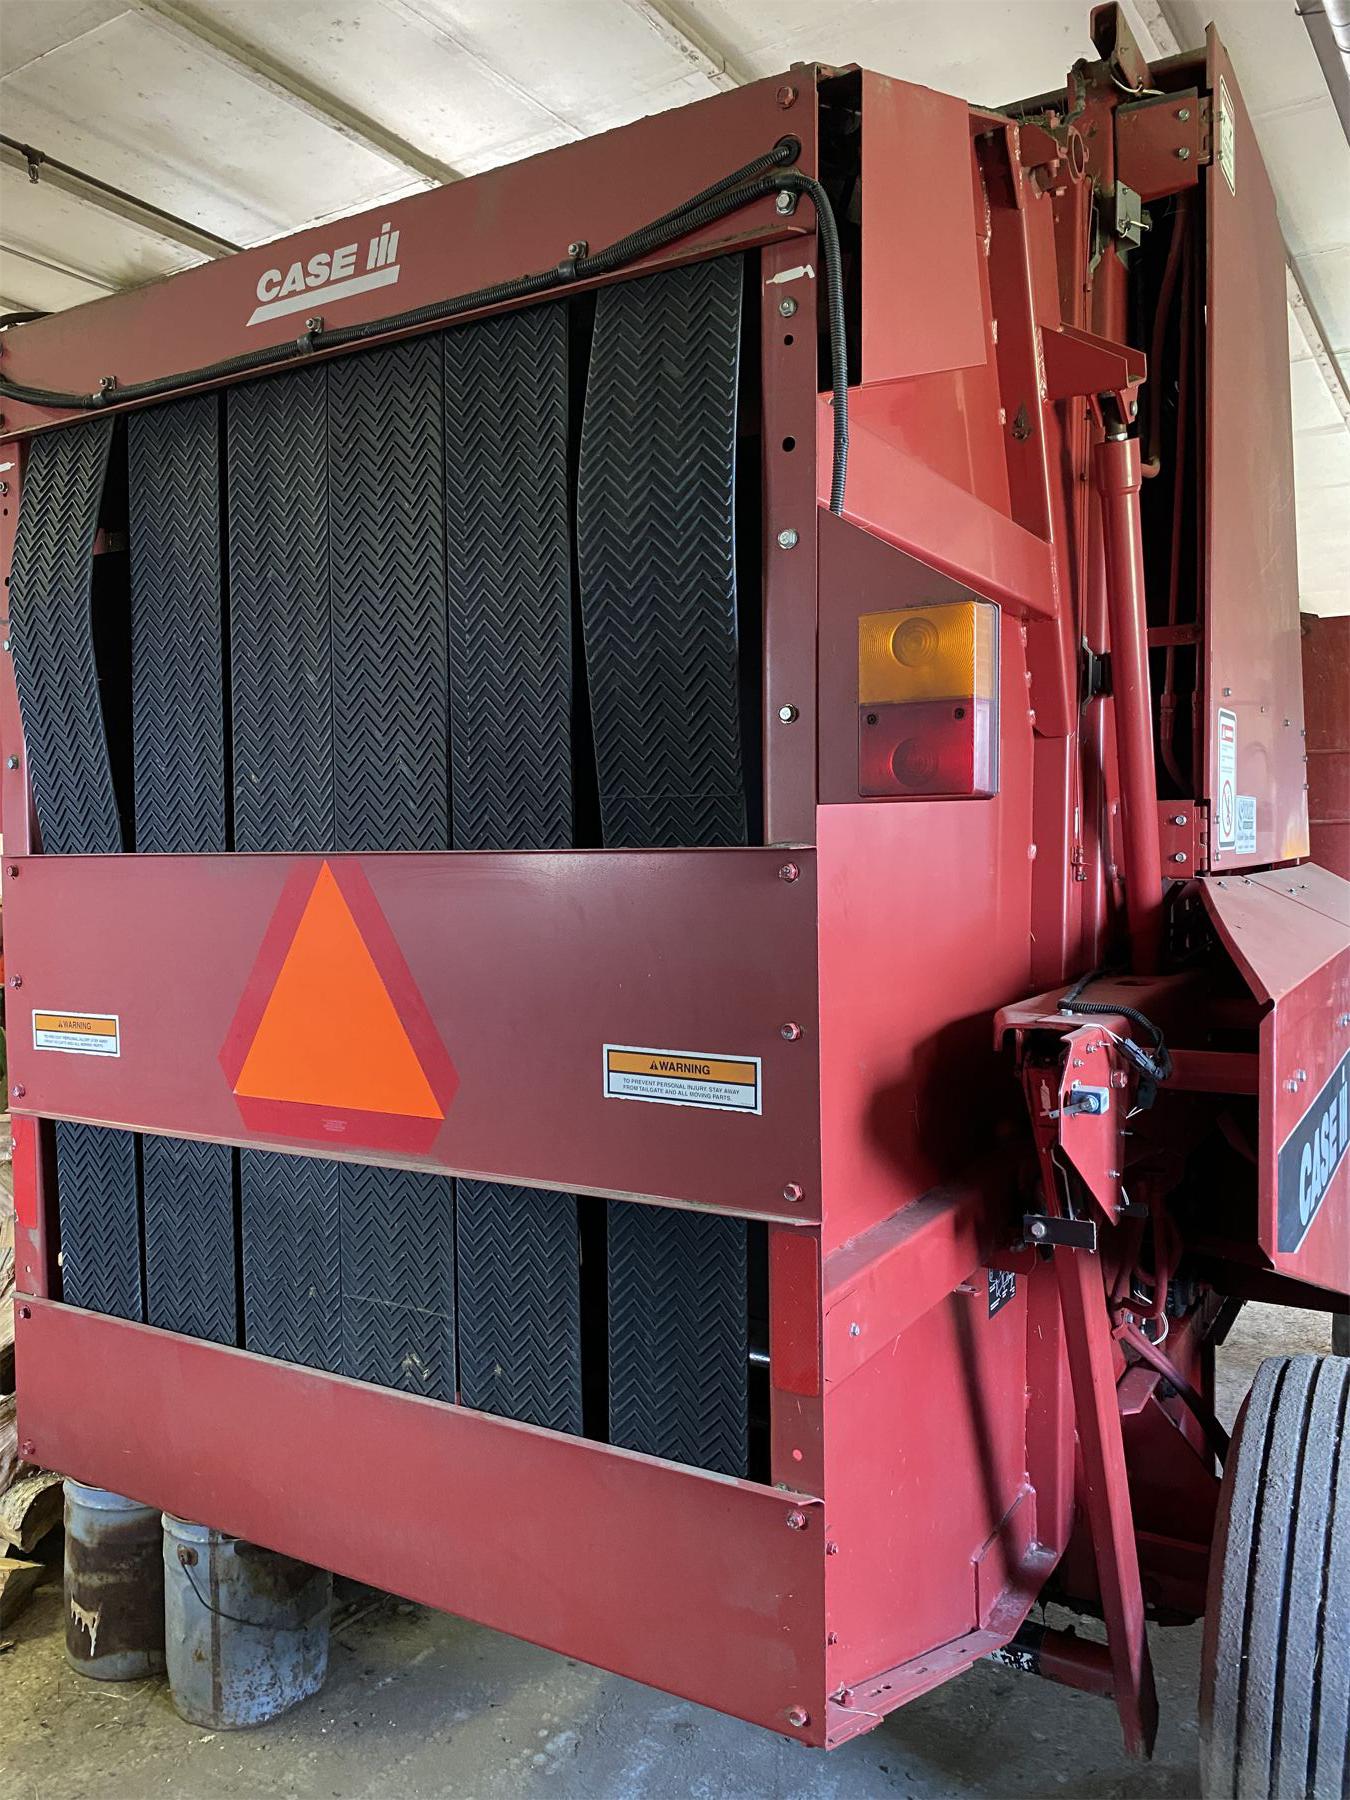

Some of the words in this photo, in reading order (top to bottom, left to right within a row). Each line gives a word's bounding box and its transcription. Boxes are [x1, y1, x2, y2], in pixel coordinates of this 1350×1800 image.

[256, 243, 358, 302] CASE
[62, 1020, 92, 1030] WARNING
[659, 1060, 711, 1075] WARNING
[631, 1078, 656, 1087] PREVENT
[656, 1081, 686, 1090] PERSONAL
[639, 1085, 665, 1094] TAILGATE
[689, 1091, 712, 1099] MOVING
[1299, 1097, 1338, 1226] CASE
